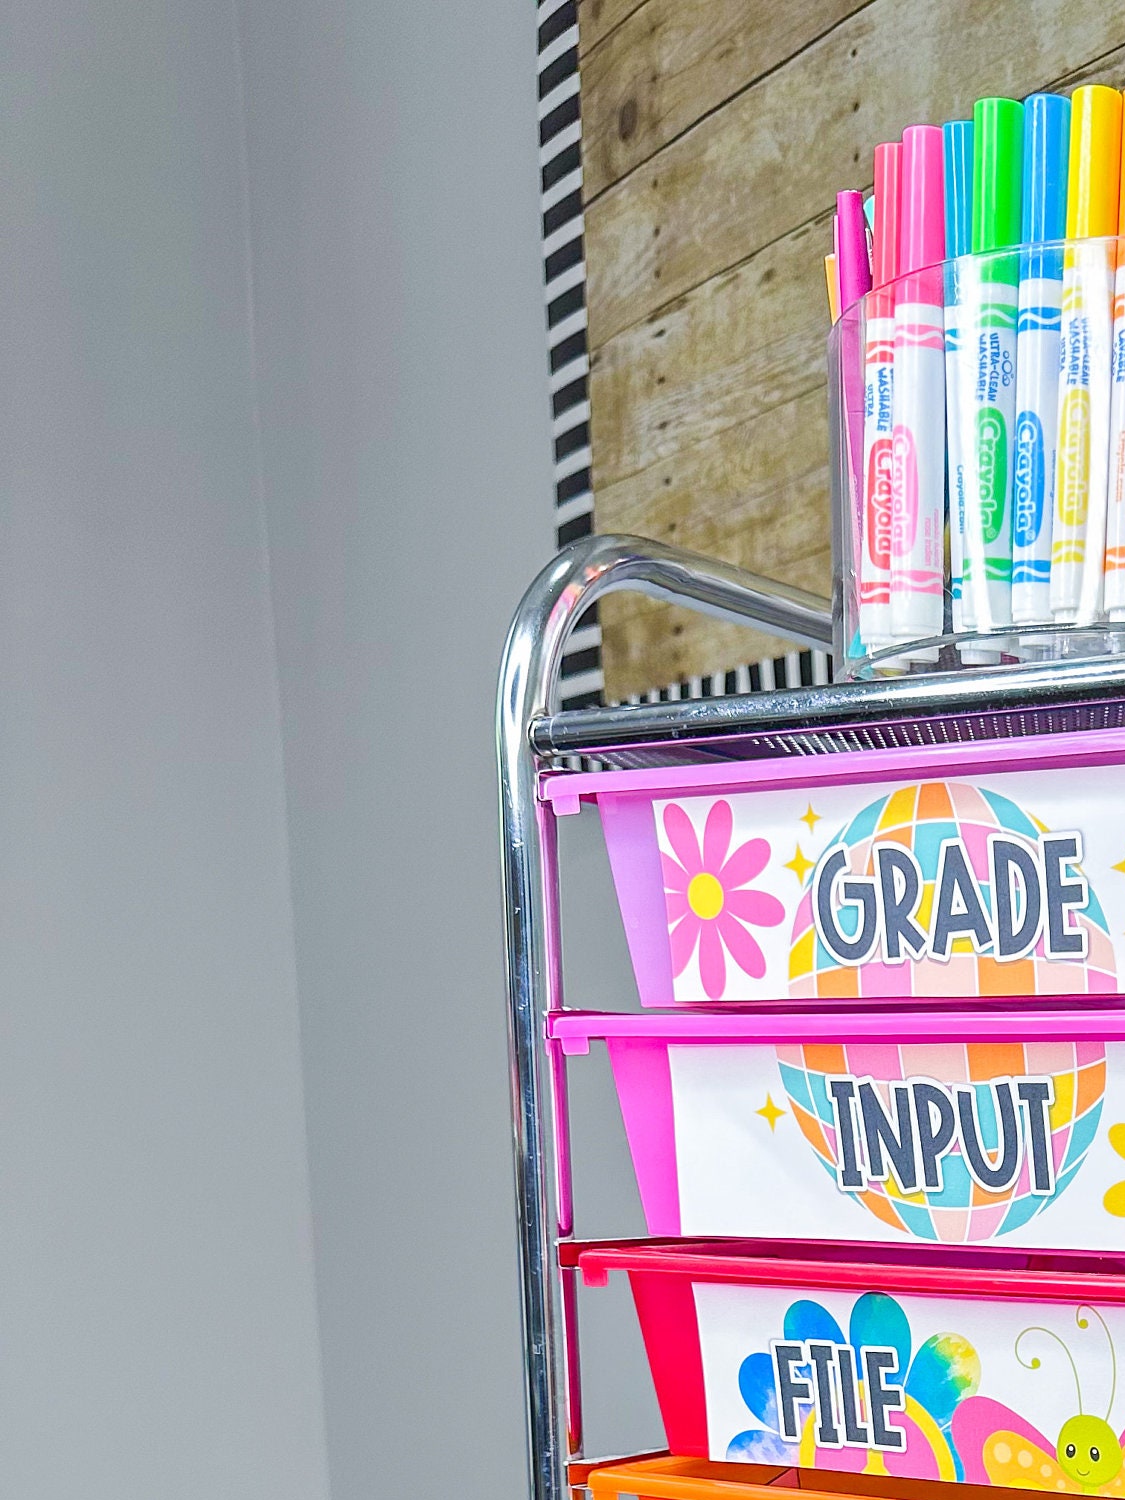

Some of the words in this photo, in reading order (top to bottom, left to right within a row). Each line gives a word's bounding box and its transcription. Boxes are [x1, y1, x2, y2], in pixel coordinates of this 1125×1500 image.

[877, 367, 890, 431] WASHABLE
[988, 332, 1001, 402] ULTRA-CLEAN
[1067, 317, 1081, 385] WASHABLE
[871, 447, 893, 554] Crayola
[893, 434, 911, 541] Crayola
[979, 418, 1001, 529] Crayola
[1015, 420, 1037, 532] Crayola
[1060, 399, 1090, 511] Crayola
[815, 836, 1089, 963] GRADE
[828, 1078, 1056, 1192] INPUT
[775, 1343, 906, 1451] FILE
